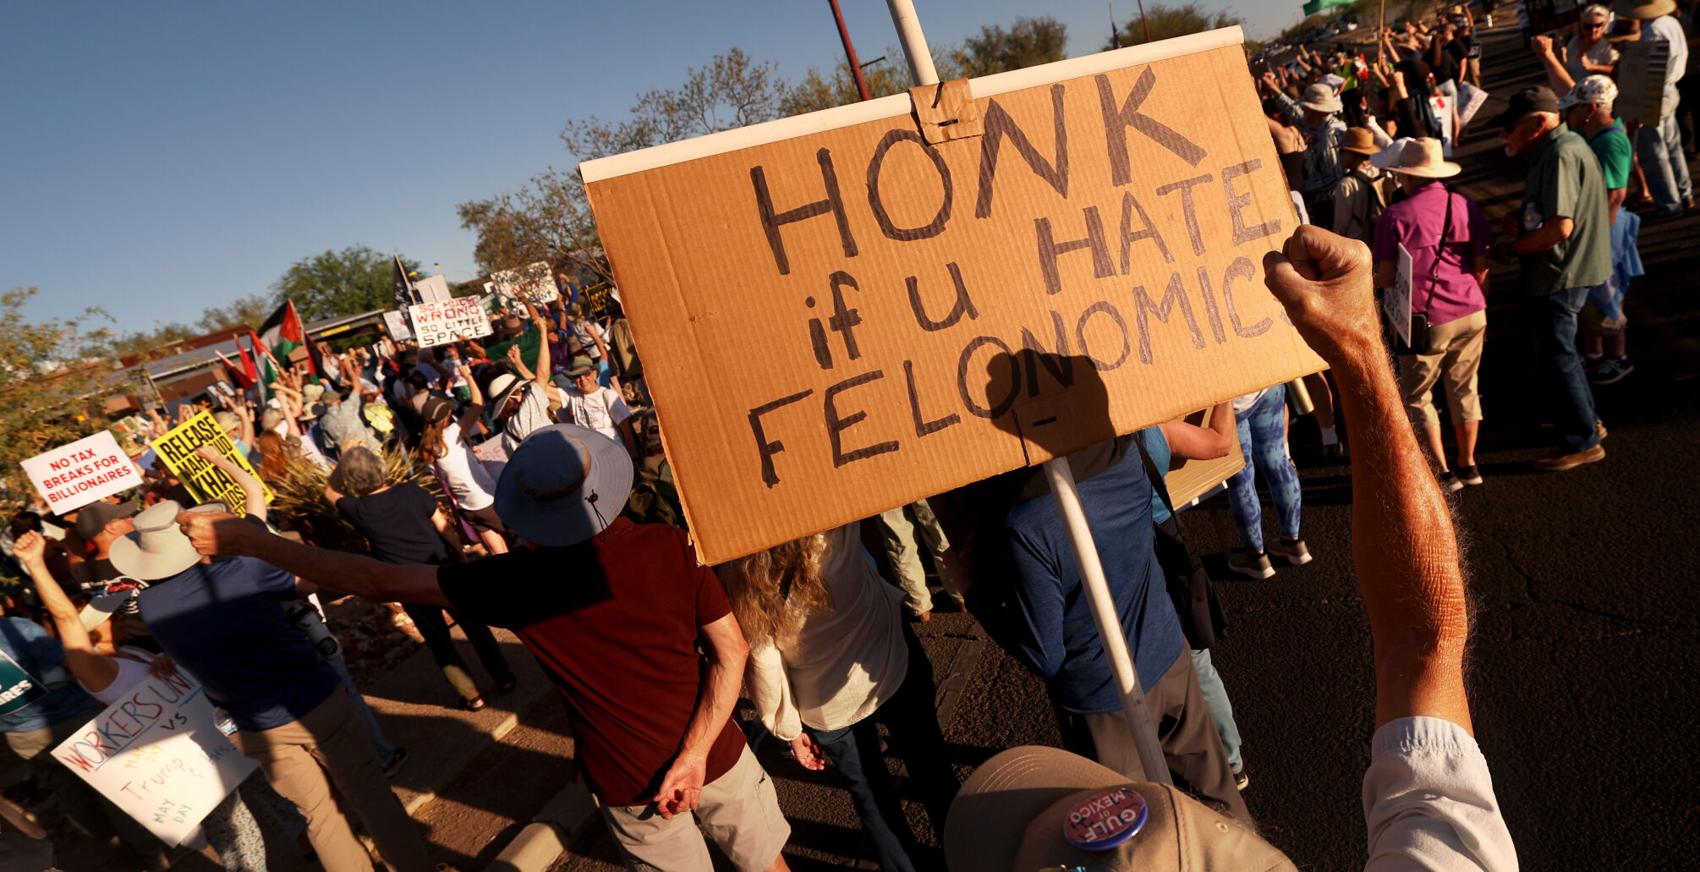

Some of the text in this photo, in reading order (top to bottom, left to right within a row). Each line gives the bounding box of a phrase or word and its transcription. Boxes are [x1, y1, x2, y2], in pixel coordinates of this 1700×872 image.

[751, 64, 1206, 276] HONK
[806, 272, 863, 370] if
[1034, 158, 1283, 296] HATE
[416, 306, 480, 323] WRONG
[418, 303, 435, 313] SO
[421, 316, 483, 334] SO LITTLE
[423, 325, 486, 346] SPACE
[748, 256, 1296, 489] FELONOMIC
[159, 416, 221, 464] RELEASE
[176, 435, 233, 477] MAHUD
[43, 455, 119, 489] BREAKS FOR
[49, 448, 96, 471] NO TAX
[48, 465, 132, 502] BILLIONAIRES
[63, 692, 164, 773] WORKERS
[120, 757, 185, 800] Trump
[154, 798, 176, 825] MAY
[174, 803, 193, 825] DAY
[1070, 790, 1126, 823] MEXICO
[1084, 808, 1137, 843] GULF
